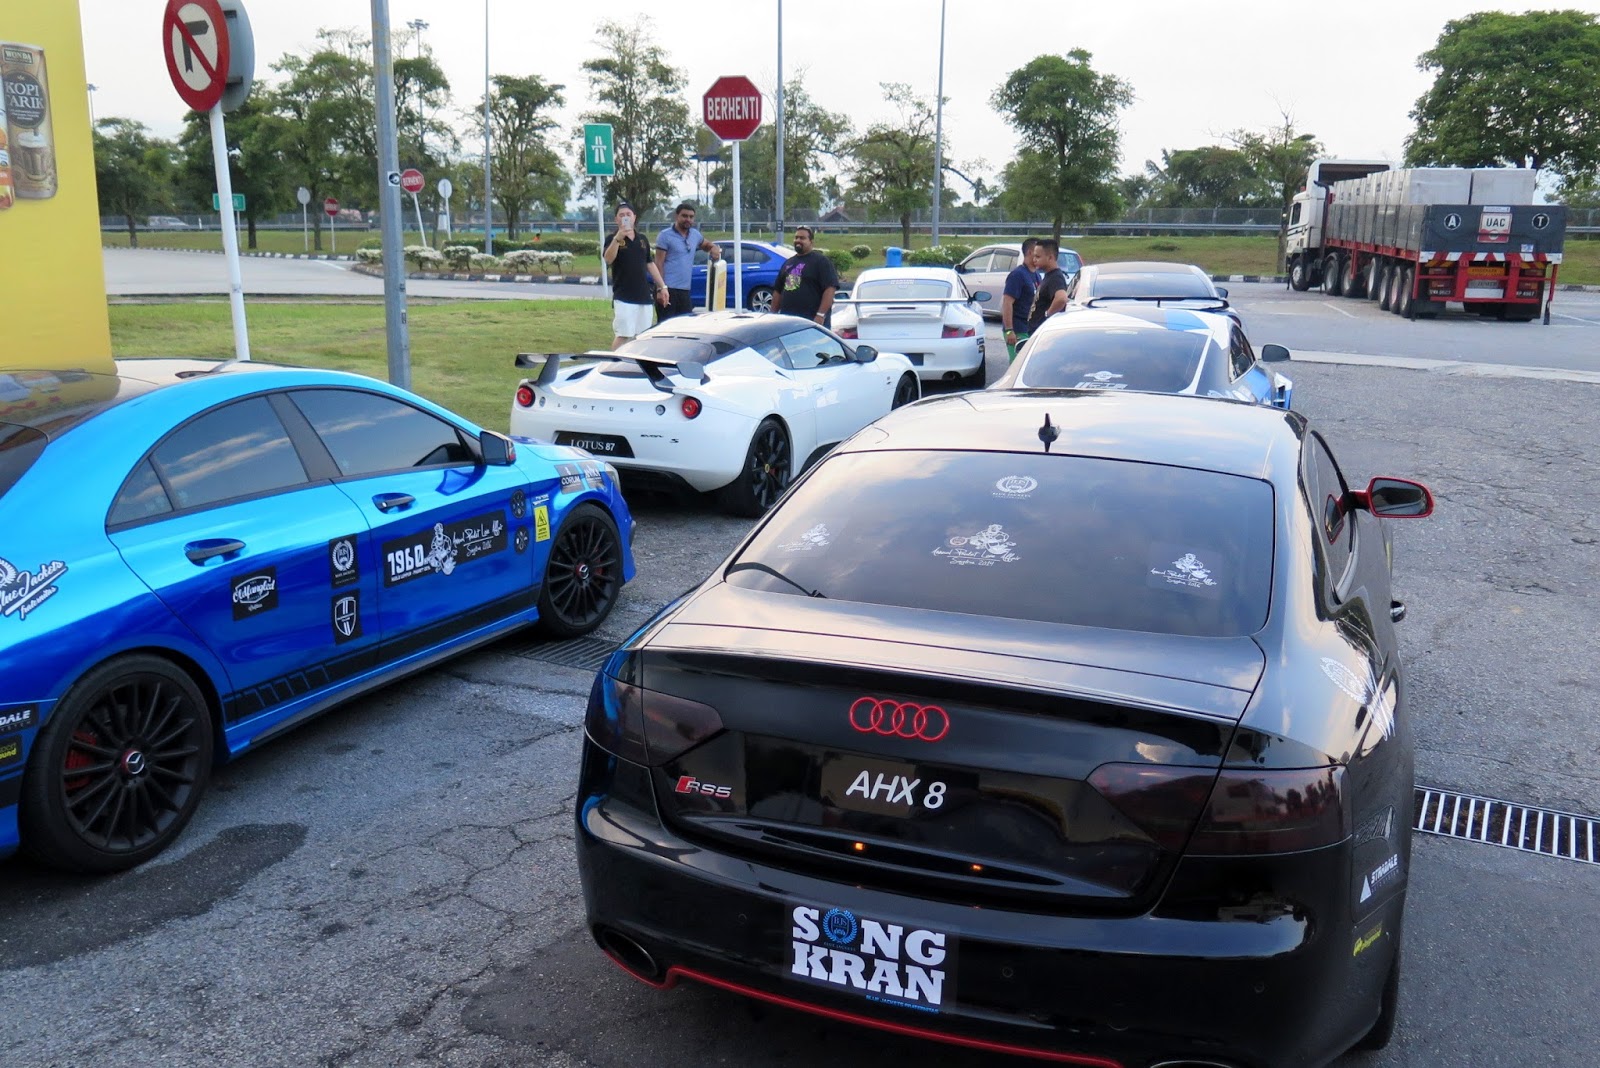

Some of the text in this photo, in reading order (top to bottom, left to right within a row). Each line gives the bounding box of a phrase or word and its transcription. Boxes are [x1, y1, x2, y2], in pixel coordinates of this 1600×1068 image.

[5, 81, 39, 97] KOPI
[707, 97, 759, 120] BERHENTI
[1485, 218, 1506, 227] UAC
[557, 402, 634, 413] LOTUS
[570, 439, 616, 452] LOTUS 87
[387, 544, 424, 576] 1960
[685, 780, 732, 798] RS5
[846, 770, 947, 809] AHX 8
[791, 940, 946, 1005] KRAN
